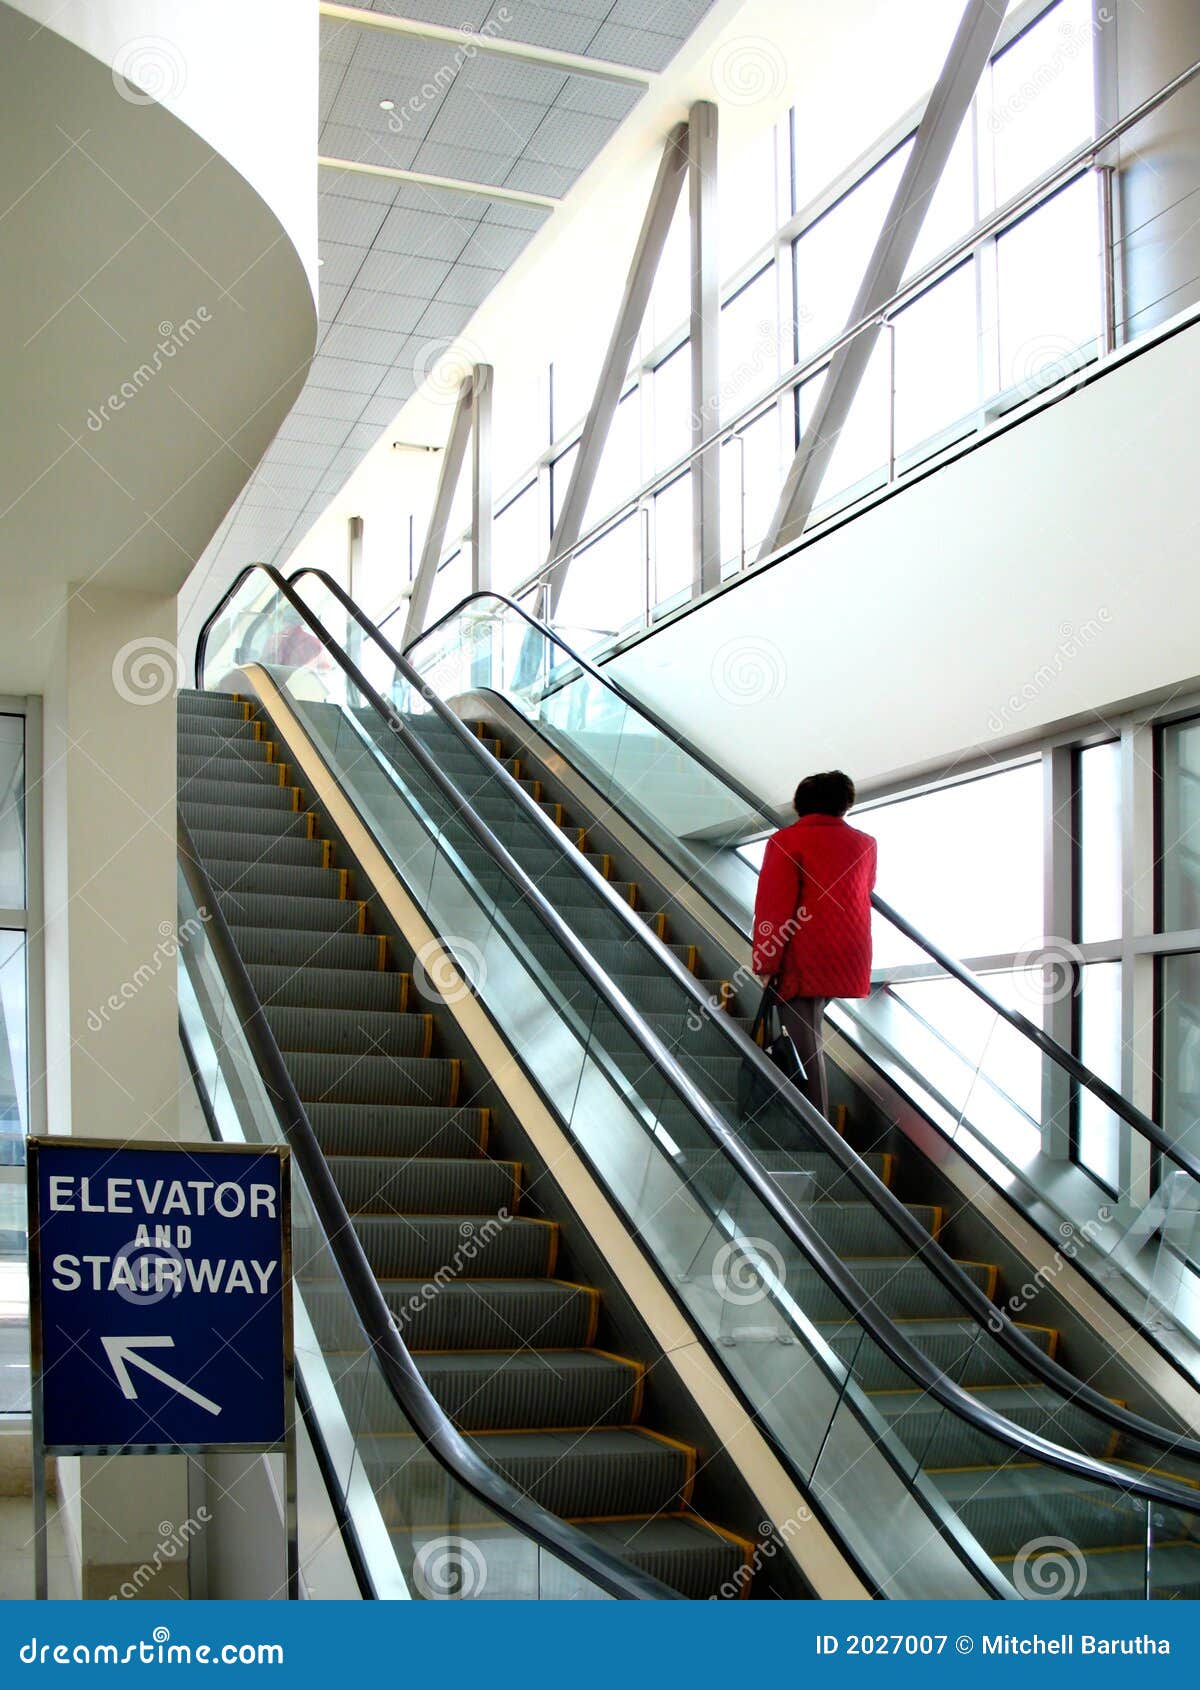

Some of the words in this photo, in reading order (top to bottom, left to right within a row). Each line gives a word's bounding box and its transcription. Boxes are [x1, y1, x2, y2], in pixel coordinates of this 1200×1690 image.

[49, 1175, 277, 1219] ELEVATOR
[134, 1223, 192, 1249] AND
[51, 1253, 277, 1294] STAIRWAY
